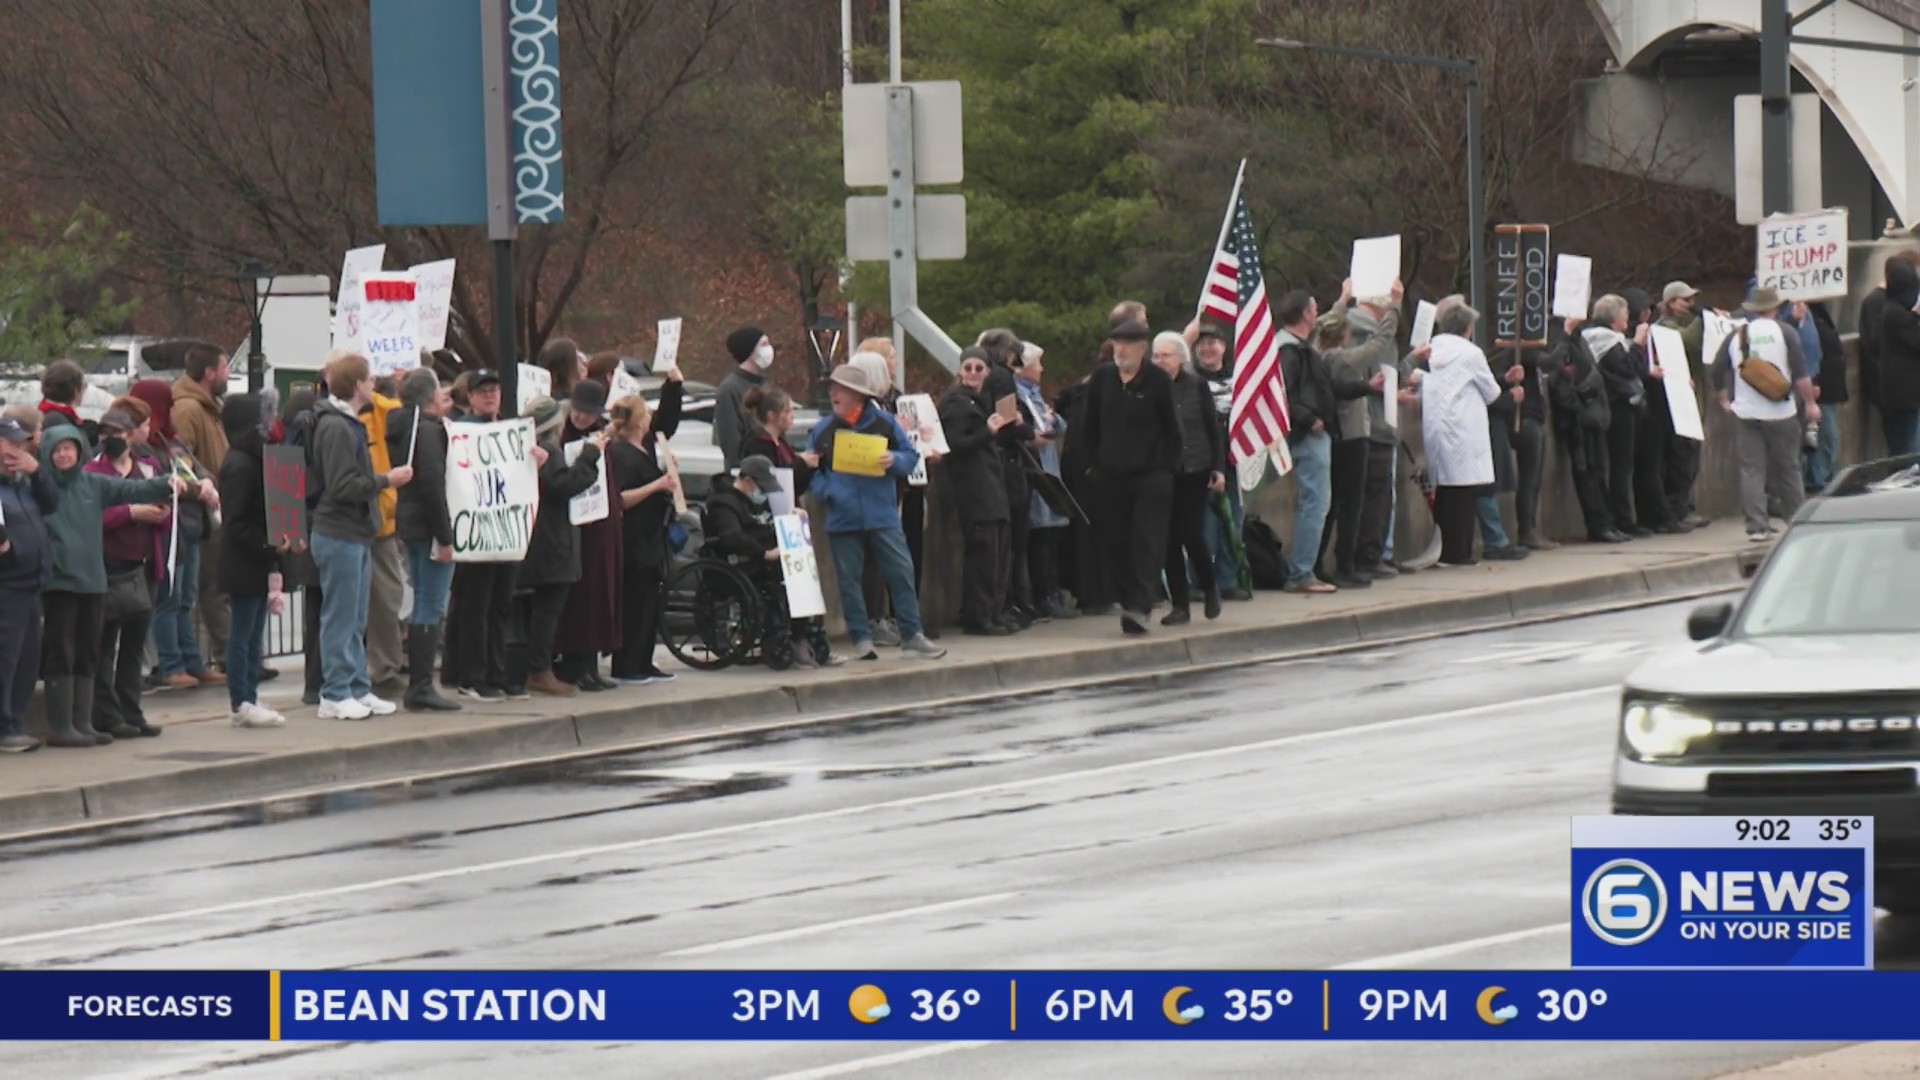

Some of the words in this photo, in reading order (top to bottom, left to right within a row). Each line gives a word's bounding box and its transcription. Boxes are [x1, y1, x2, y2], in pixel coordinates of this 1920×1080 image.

[1766, 225, 1807, 249] ICE
[1766, 242, 1838, 271] TRUMP
[1498, 240, 1518, 336] RENEE
[1524, 247, 1545, 332] GOOD
[1763, 266, 1844, 291] GESTAPO
[367, 336, 414, 354] WEEPS
[1714, 717, 1913, 734] BRONCO
